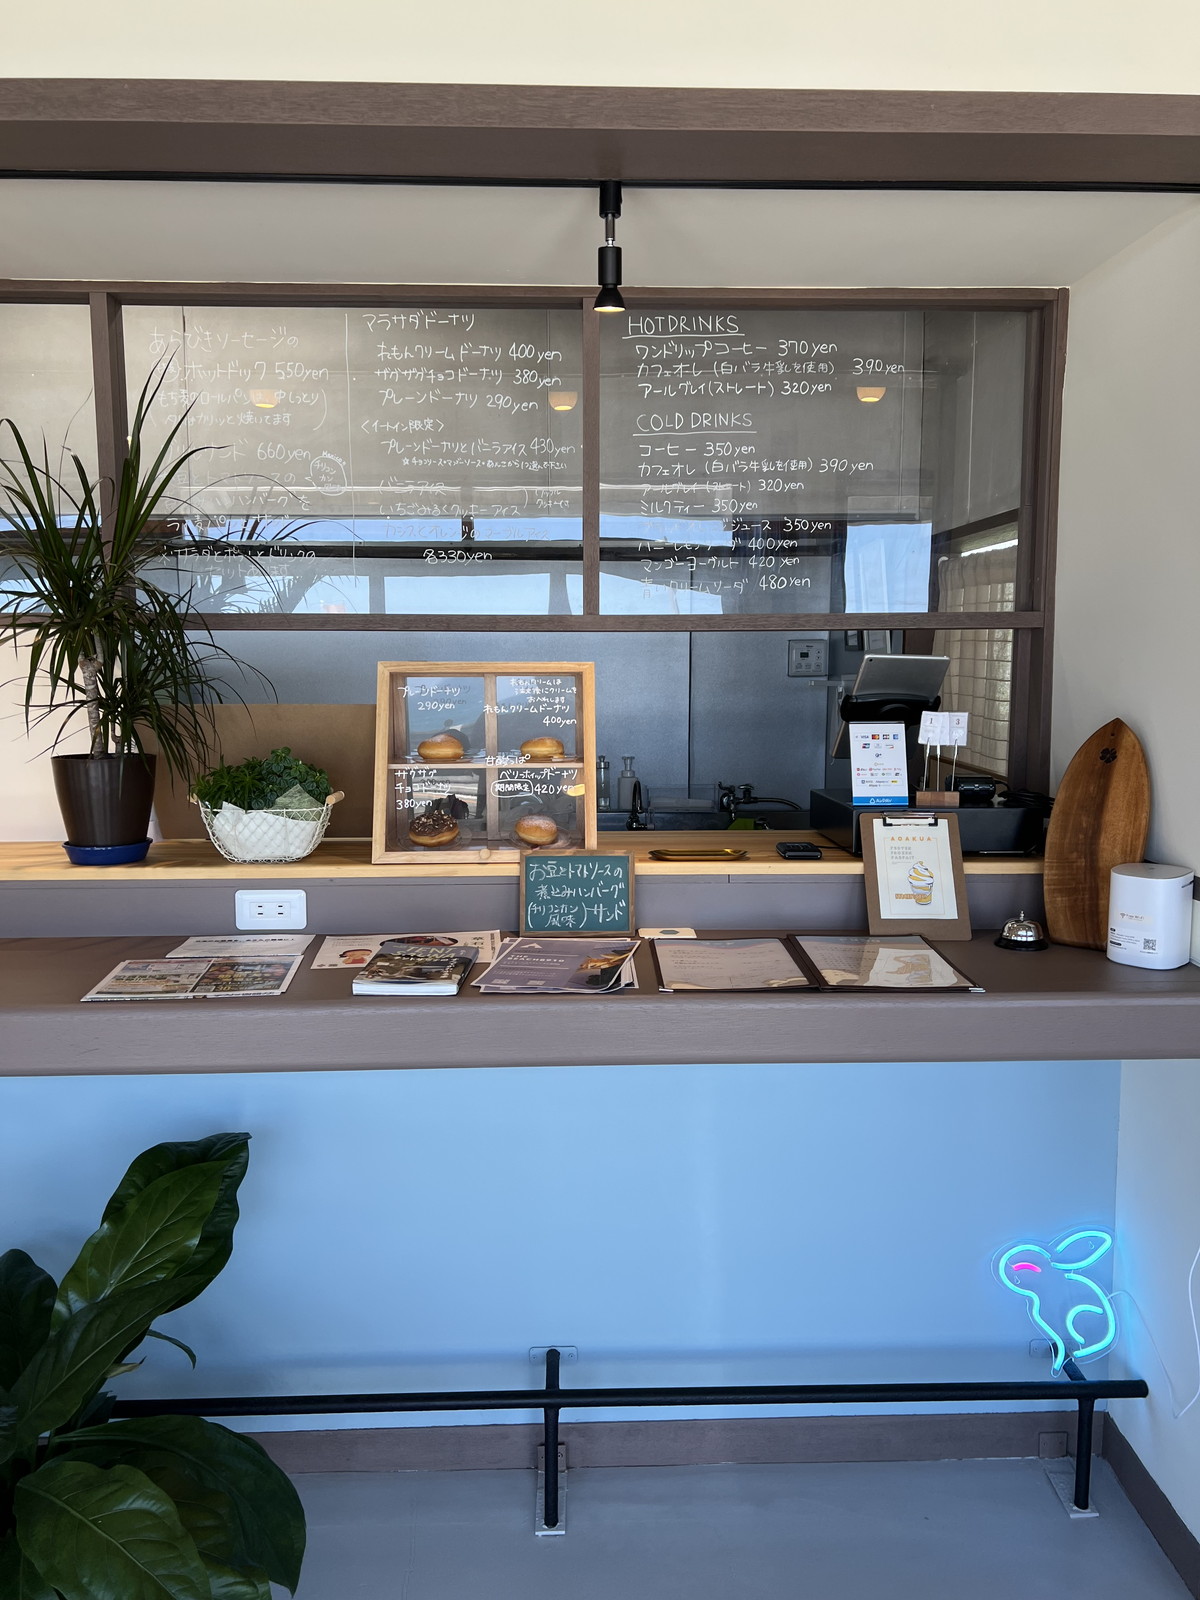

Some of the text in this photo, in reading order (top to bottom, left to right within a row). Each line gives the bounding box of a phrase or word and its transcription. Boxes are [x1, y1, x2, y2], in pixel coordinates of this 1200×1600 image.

[362, 309, 475, 332] マラサダドーナツ
[149, 326, 299, 353] あらびきソーセージの
[635, 340, 768, 359] ワンドリップコーヒー
[378, 388, 478, 409] プレーンドーナツ
[636, 411, 753, 432] COLD DRINKS
[257, 442, 311, 464] 660yen
[638, 441, 697, 457] コーヒー
[638, 462, 696, 478] カフェオレ
[640, 500, 705, 516] ミルクティー
[640, 555, 739, 573] マンゴーヨーグルト
[417, 701, 456, 711] 290yen
[543, 715, 577, 728] 400yen
[396, 798, 432, 810] 380yen
[529, 861, 623, 882] お豆とトマトソースの
[535, 881, 625, 900] 煮込みハンバーグ
[406, 946, 457, 954] TENT
